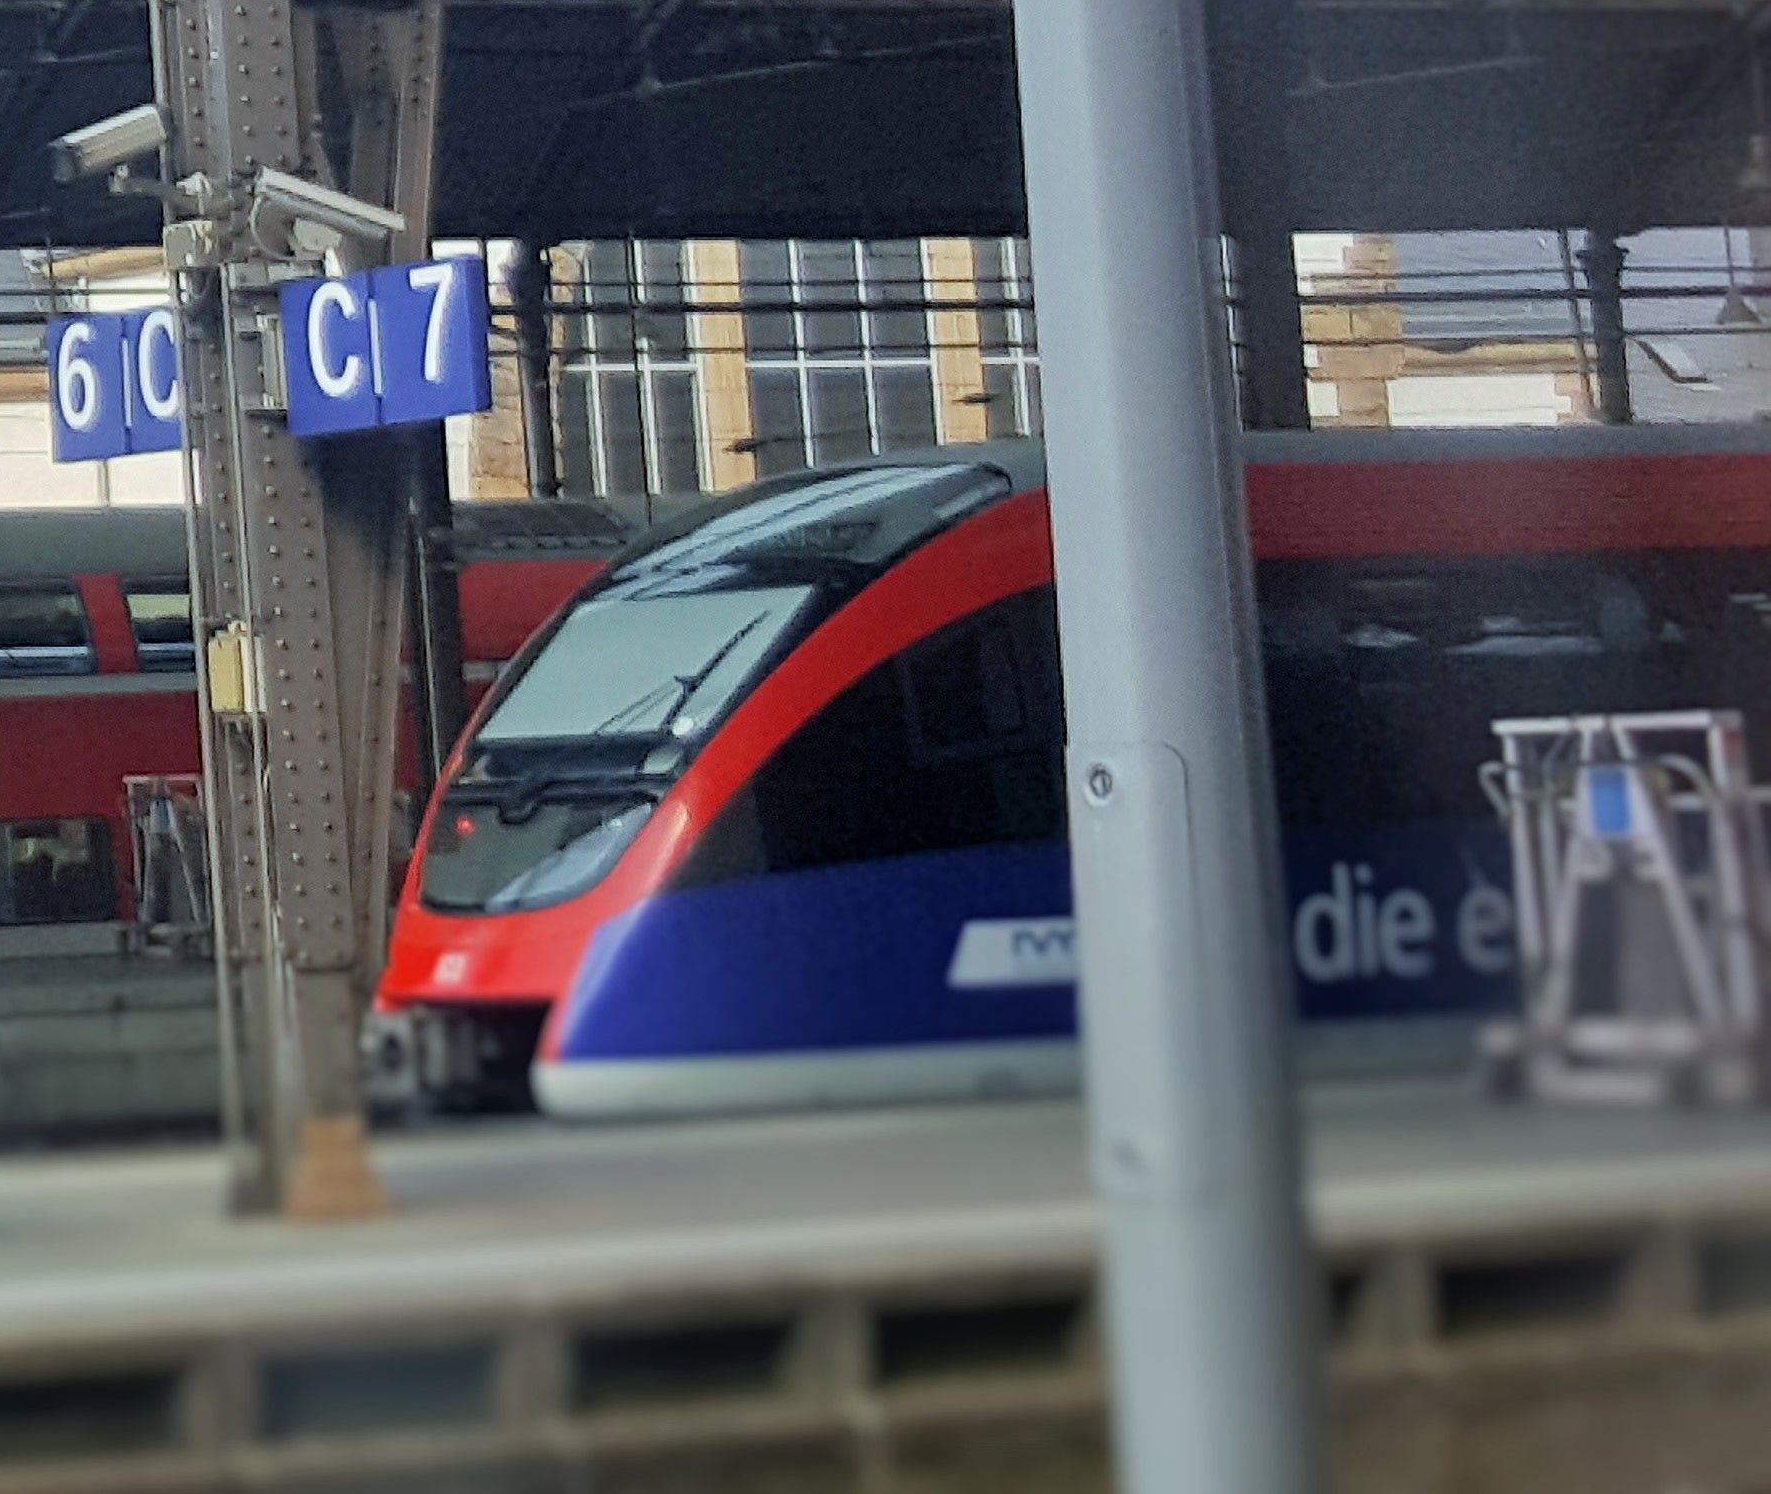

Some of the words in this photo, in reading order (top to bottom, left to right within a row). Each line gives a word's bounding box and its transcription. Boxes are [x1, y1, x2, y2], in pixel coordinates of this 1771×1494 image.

[58, 321, 99, 432] 6
[137, 309, 181, 419] C
[307, 280, 360, 399] C
[409, 263, 455, 382] 7
[1294, 861, 1437, 984] die
